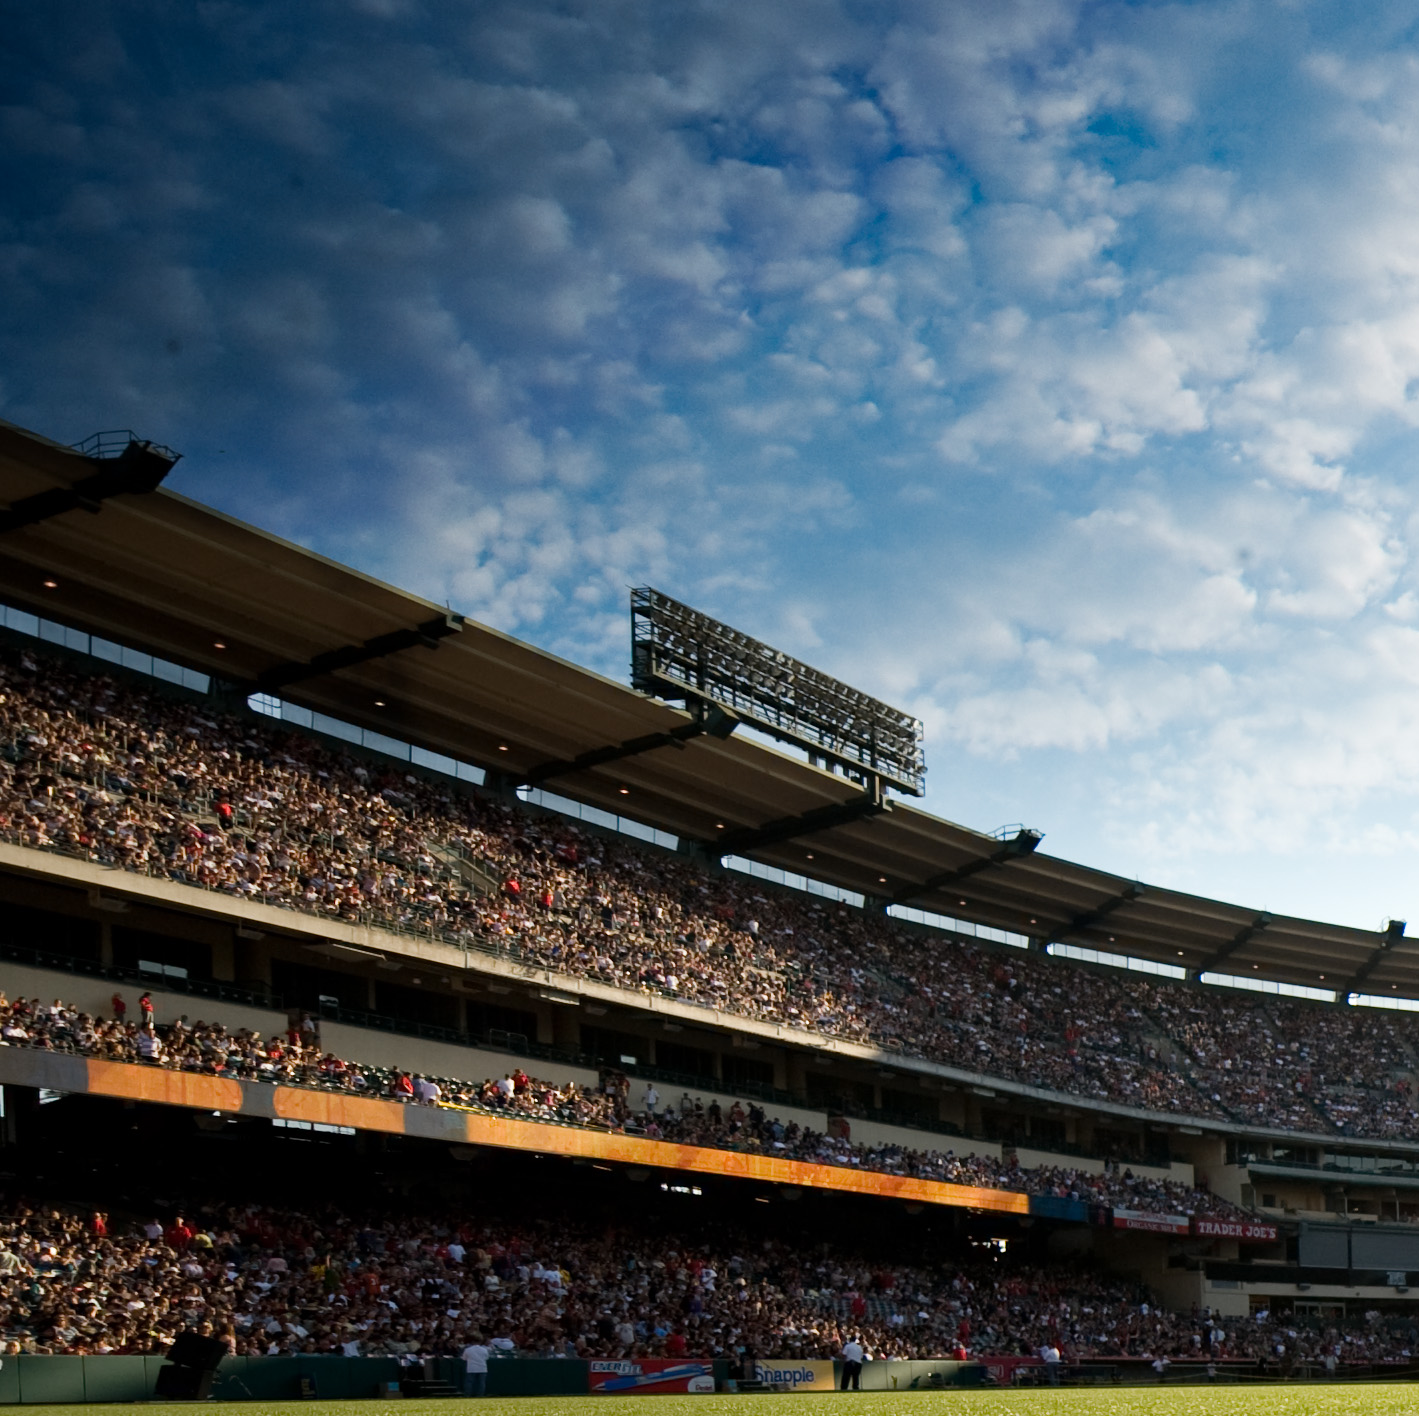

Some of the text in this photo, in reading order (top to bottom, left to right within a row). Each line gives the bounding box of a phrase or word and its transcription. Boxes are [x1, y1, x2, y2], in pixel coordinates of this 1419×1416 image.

[1198, 1222, 1277, 1240] TRADER JOE'S
[755, 1365, 815, 1387] Snapple
